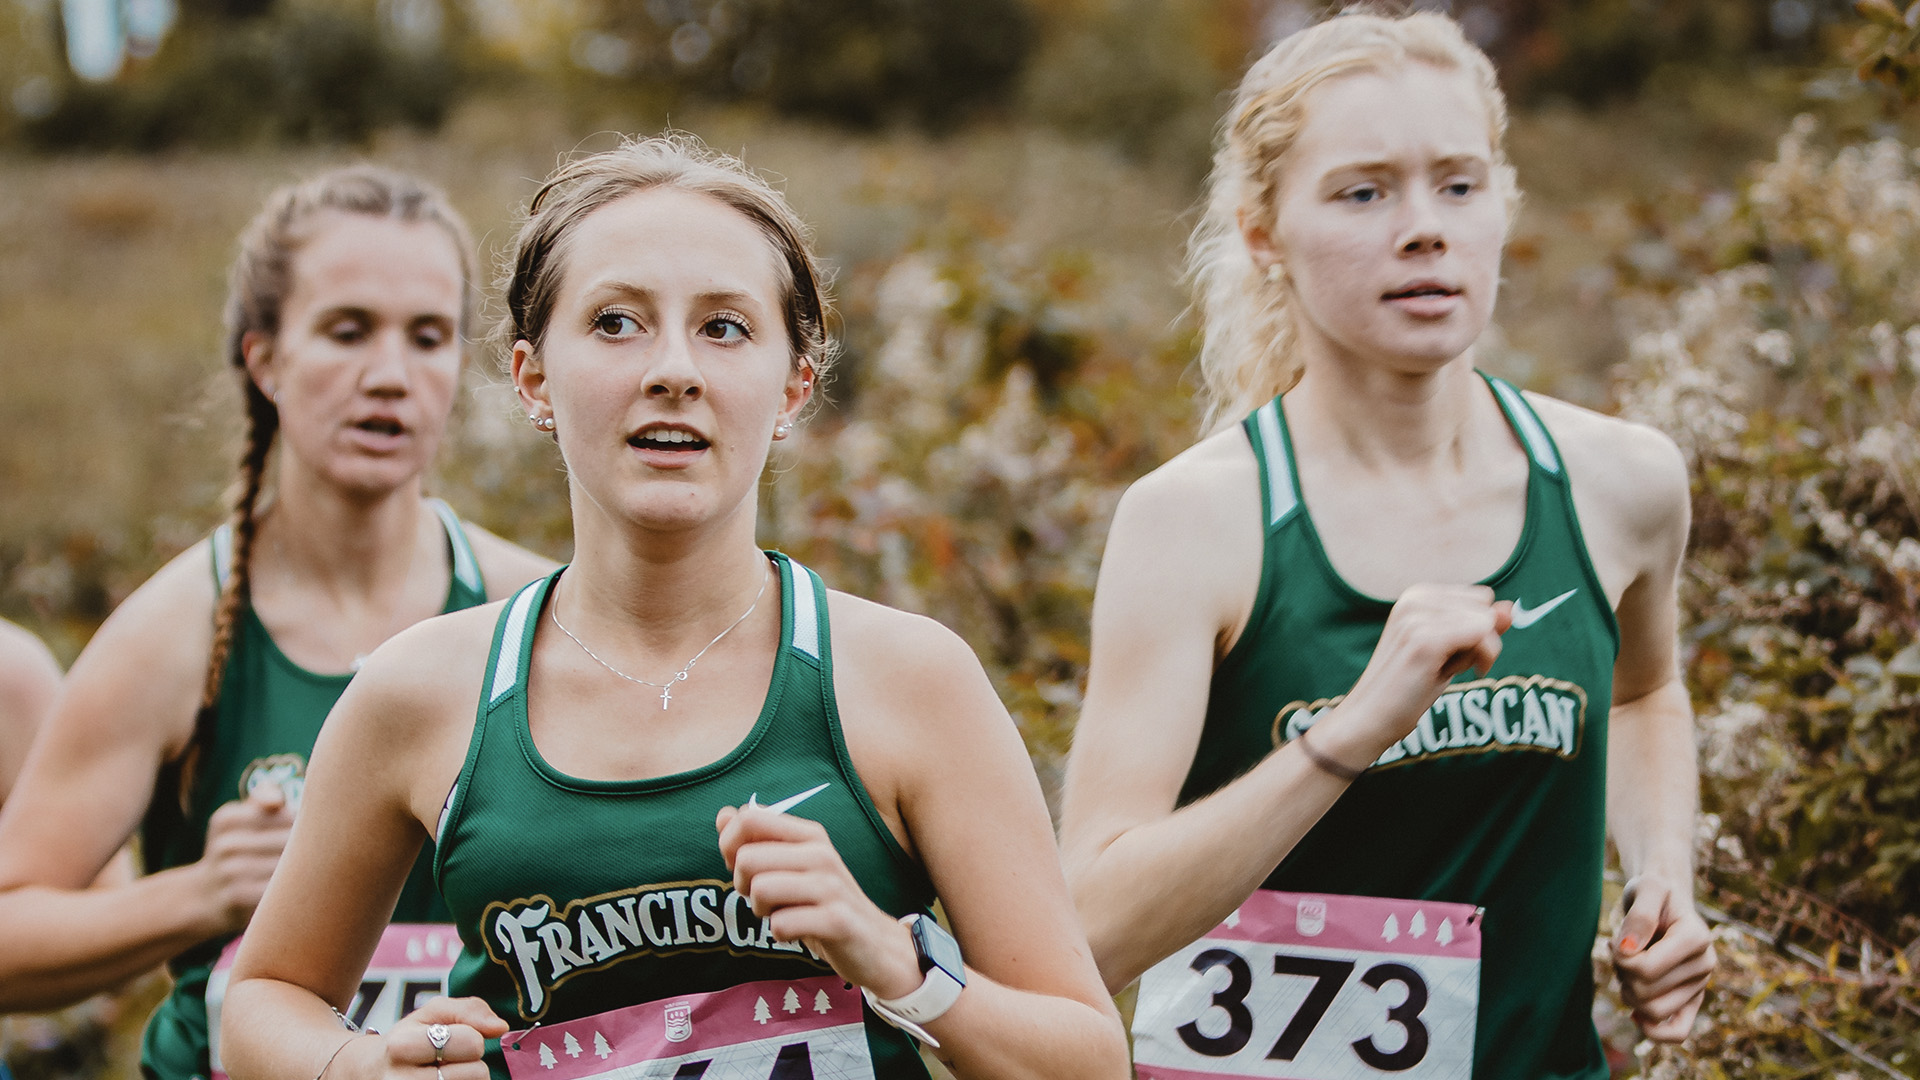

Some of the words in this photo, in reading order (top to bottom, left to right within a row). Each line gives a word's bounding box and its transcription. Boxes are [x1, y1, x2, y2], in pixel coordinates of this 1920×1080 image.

[1286, 687, 1576, 767] CISCAN
[496, 888, 820, 1013] FRANCISC
[1176, 948, 1430, 1072] 373
